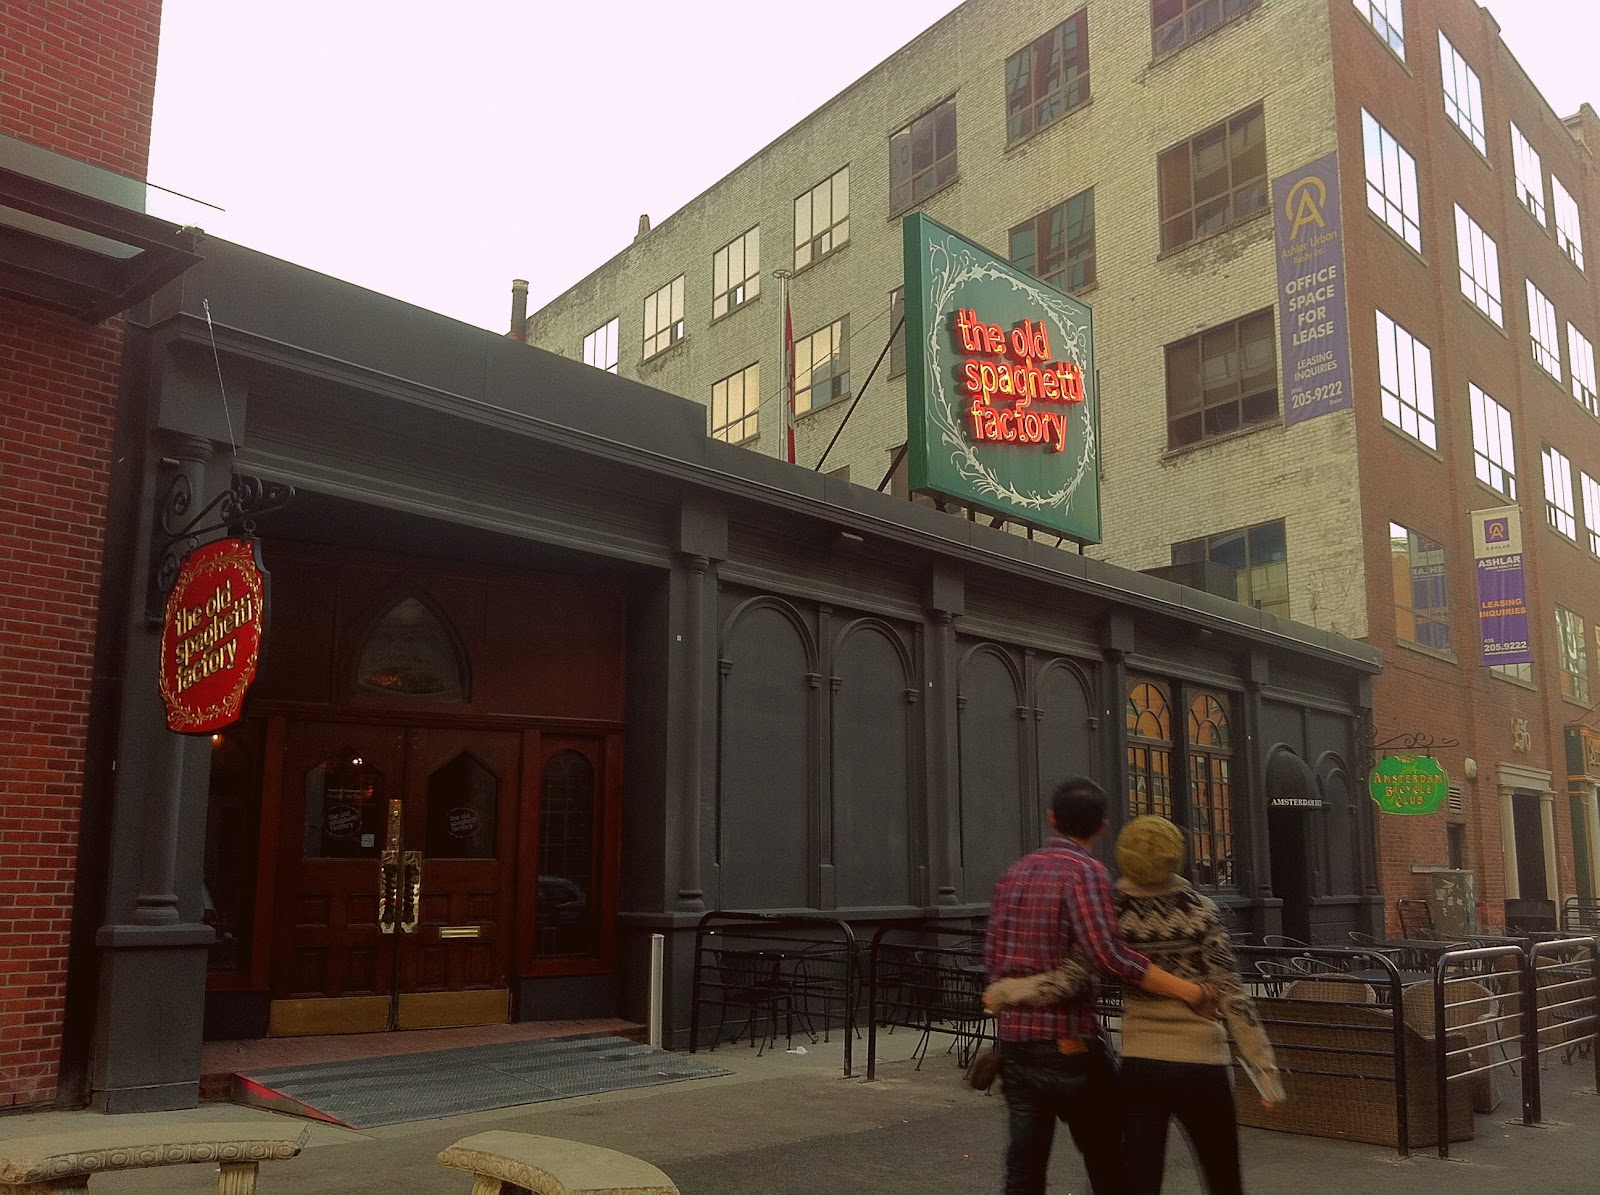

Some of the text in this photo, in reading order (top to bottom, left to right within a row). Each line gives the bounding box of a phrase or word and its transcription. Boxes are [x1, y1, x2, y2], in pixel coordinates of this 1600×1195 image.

[1310, 230, 1338, 247] Urban
[1285, 265, 1337, 295] OFFICE
[1288, 284, 1335, 312] SPACE
[1297, 306, 1326, 327] FOR
[957, 308, 1051, 361] the old
[1292, 320, 1334, 347] LEASE
[1294, 360, 1338, 382] INQUIRIES
[1297, 350, 1333, 370] LEASING
[965, 354, 1084, 408] spaghetti
[1292, 380, 1343, 409] 205-9222
[971, 394, 1067, 452] factory
[1478, 555, 1521, 568] ASHLAR
[175, 578, 232, 638] the old
[1479, 607, 1526, 618] INQUIRIES
[1482, 598, 1522, 609] LEASING
[175, 593, 253, 667] spaghetti
[1484, 641, 1527, 652] 205.9222
[176, 637, 238, 694] factory
